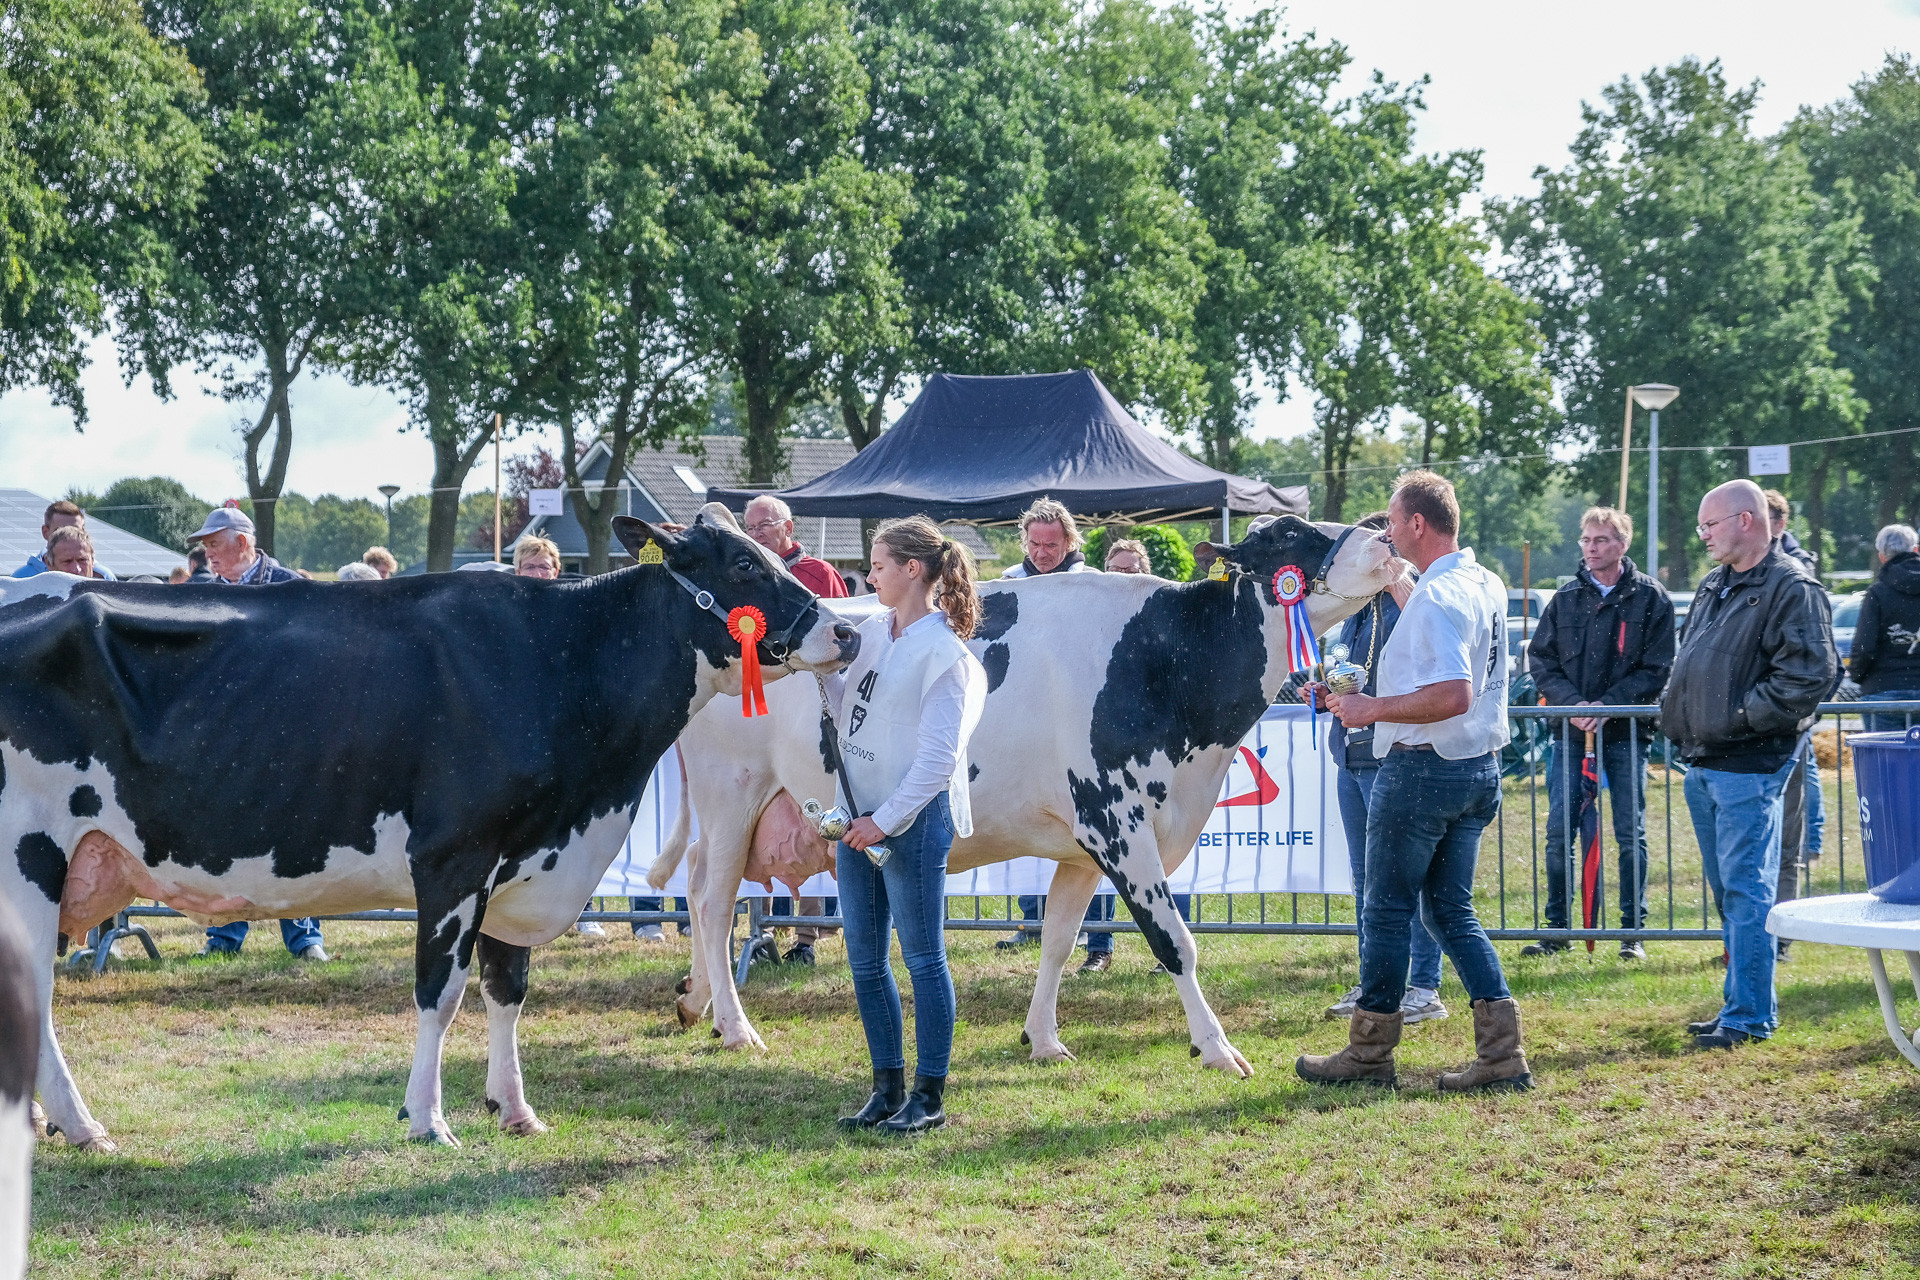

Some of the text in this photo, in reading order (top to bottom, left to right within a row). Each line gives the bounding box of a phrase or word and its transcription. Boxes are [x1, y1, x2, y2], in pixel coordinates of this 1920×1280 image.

[857, 669, 879, 704] 41
[1199, 830, 1314, 847] BETTER LIFE
